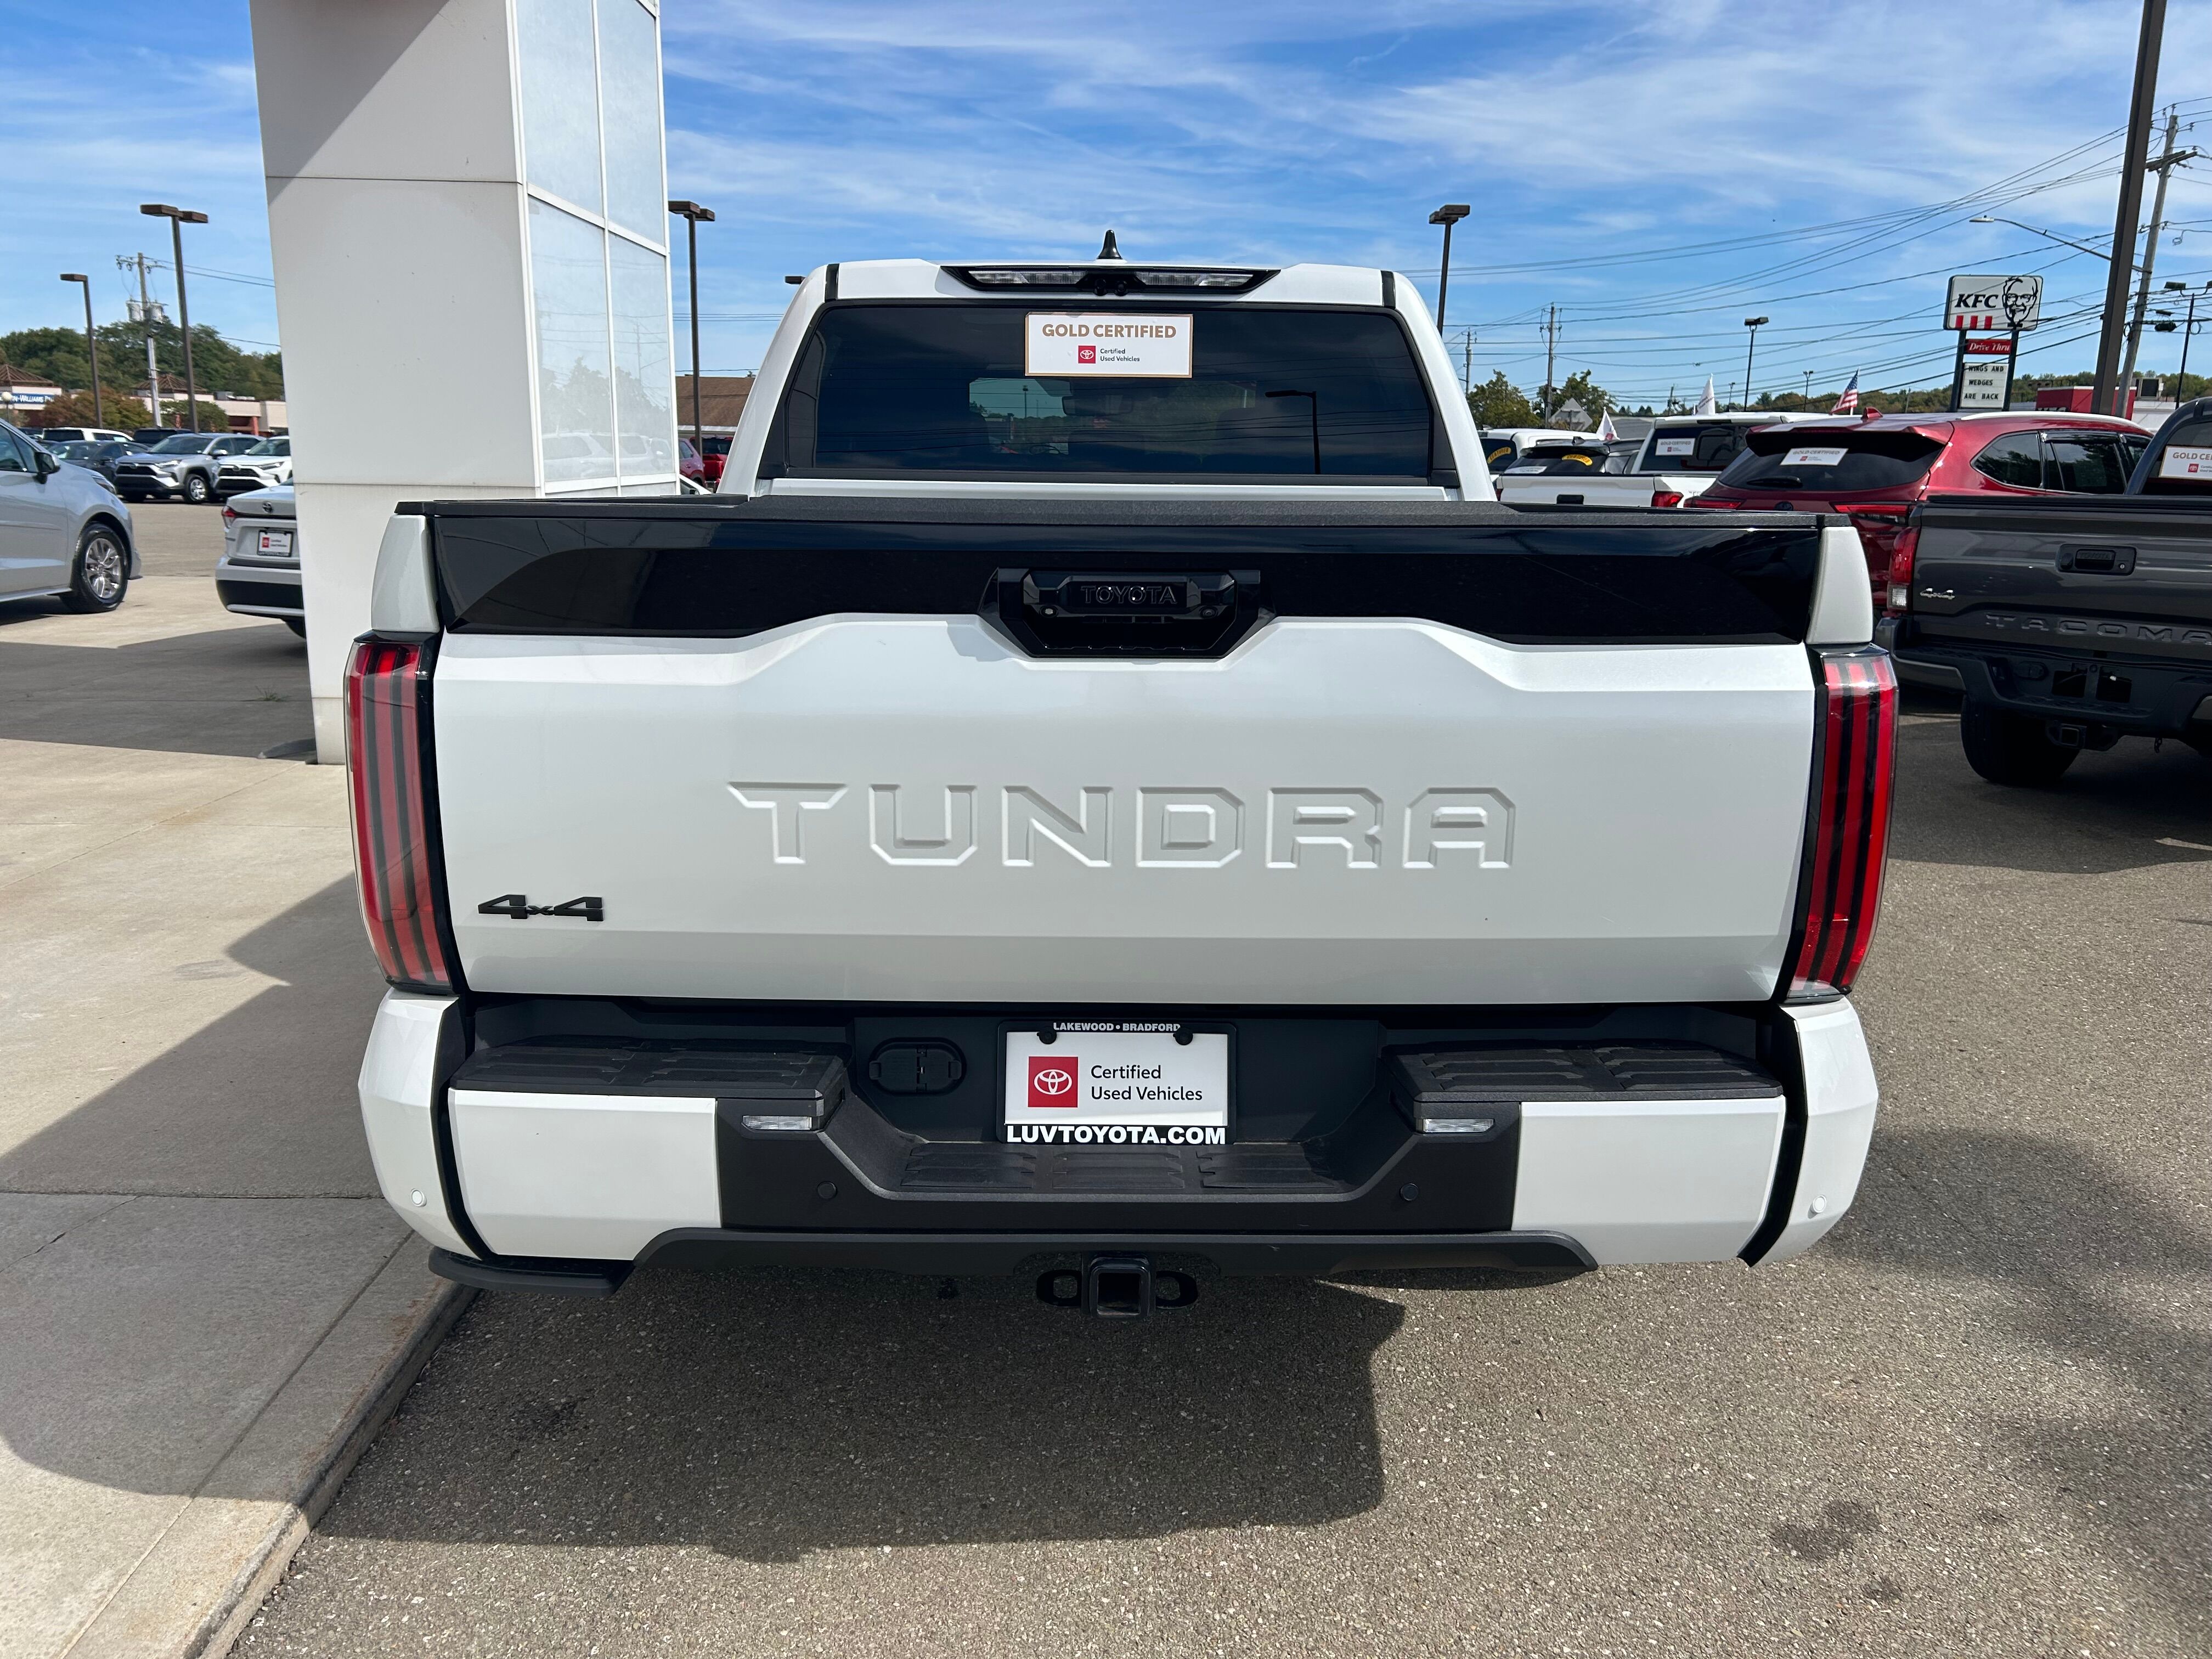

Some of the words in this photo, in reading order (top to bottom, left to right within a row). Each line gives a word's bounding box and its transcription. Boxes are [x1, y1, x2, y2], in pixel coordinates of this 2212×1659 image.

[1955, 294, 1999, 308] KFC
[1042, 324, 1090, 338] GOLD
[1093, 324, 1177, 338] CERTIFIED
[1969, 342, 1990, 351] Drive
[1992, 342, 2010, 351] Thru
[1081, 585, 1178, 605] TOYOTA
[1985, 612, 2212, 646] TACOMA
[727, 782, 1516, 870] TUNDRA
[478, 894, 603, 922] 4x4
[1053, 1022, 1114, 1031] LAKEWOOD
[1122, 1023, 1181, 1031] BRADFORD
[1091, 1064, 1161, 1079] Certified
[1091, 1086, 1131, 1100] Used
[1136, 1086, 1203, 1101] Vehicles
[1007, 1125, 1226, 1145] LUVTOYOTA.COM
